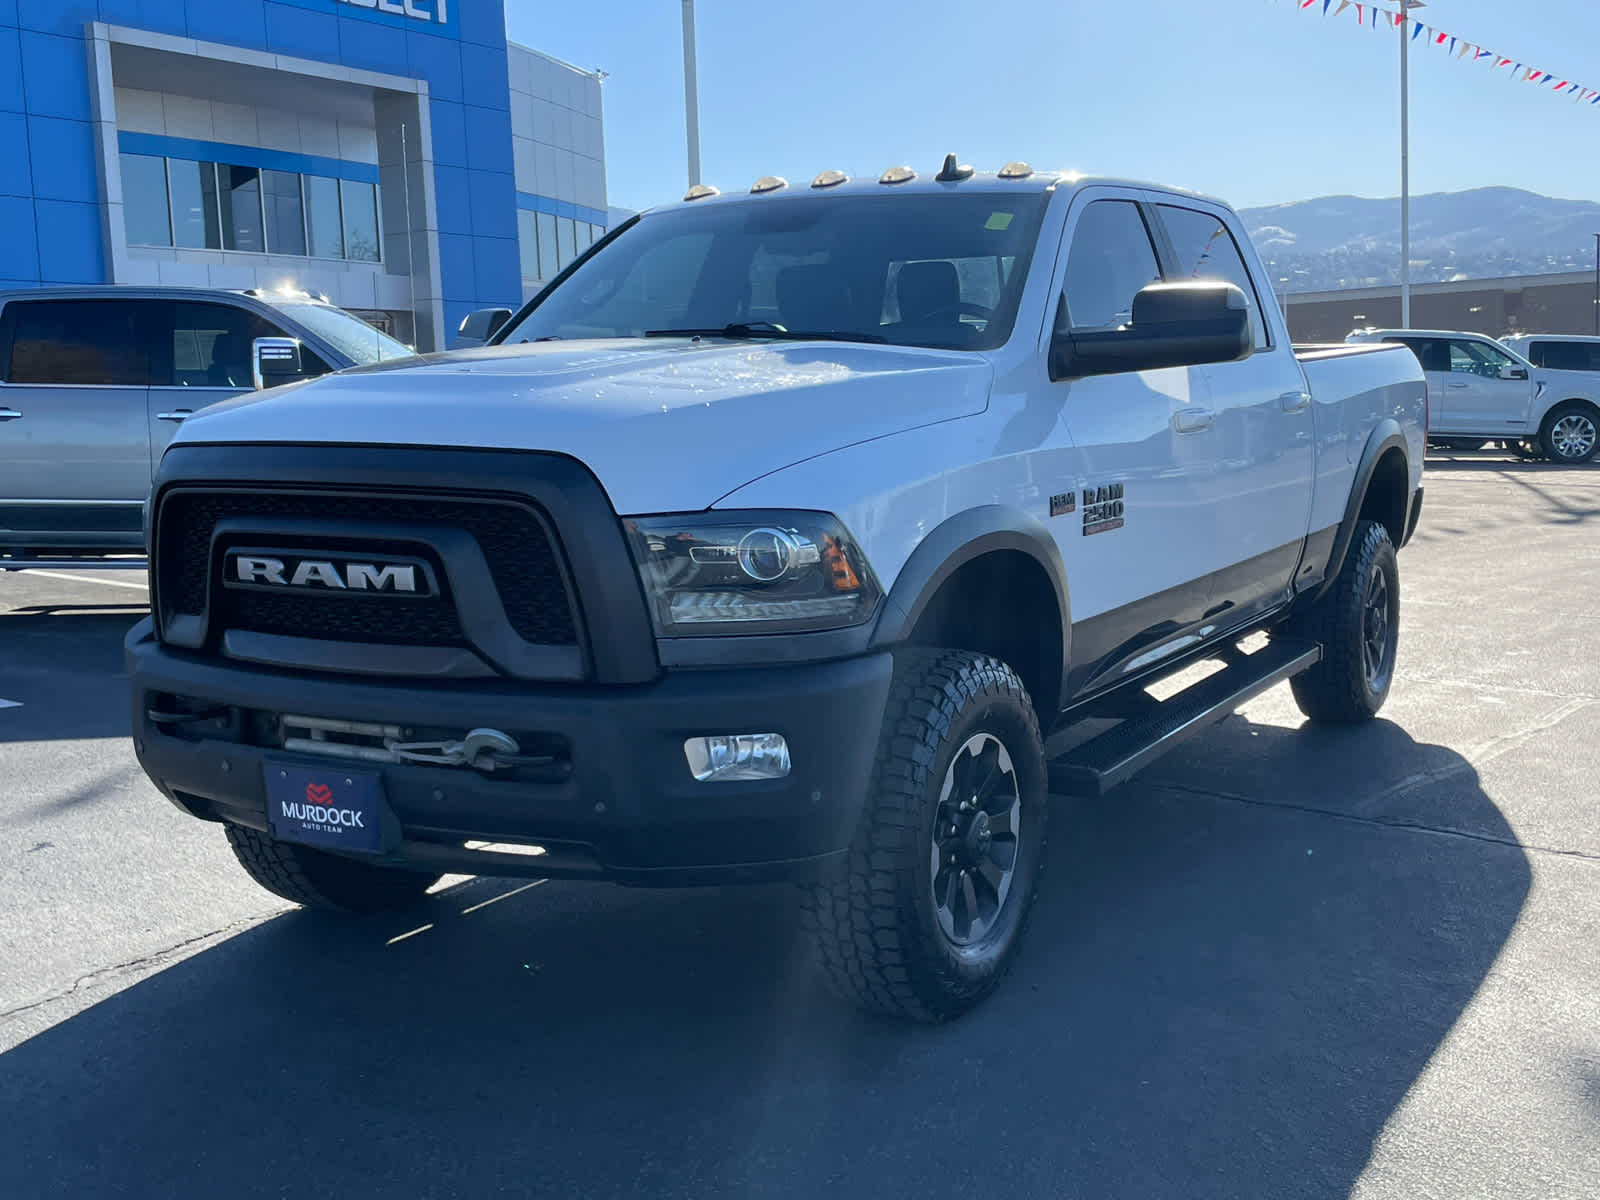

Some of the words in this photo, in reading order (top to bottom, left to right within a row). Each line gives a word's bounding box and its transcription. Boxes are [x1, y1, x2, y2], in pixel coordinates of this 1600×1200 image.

[1083, 484, 1124, 505] RAM
[1083, 501, 1124, 524] 2500
[237, 556, 415, 592] RAM
[282, 801, 364, 828] MURDOCK
[302, 822, 321, 831] AUTO
[323, 825, 342, 833] TEAM
